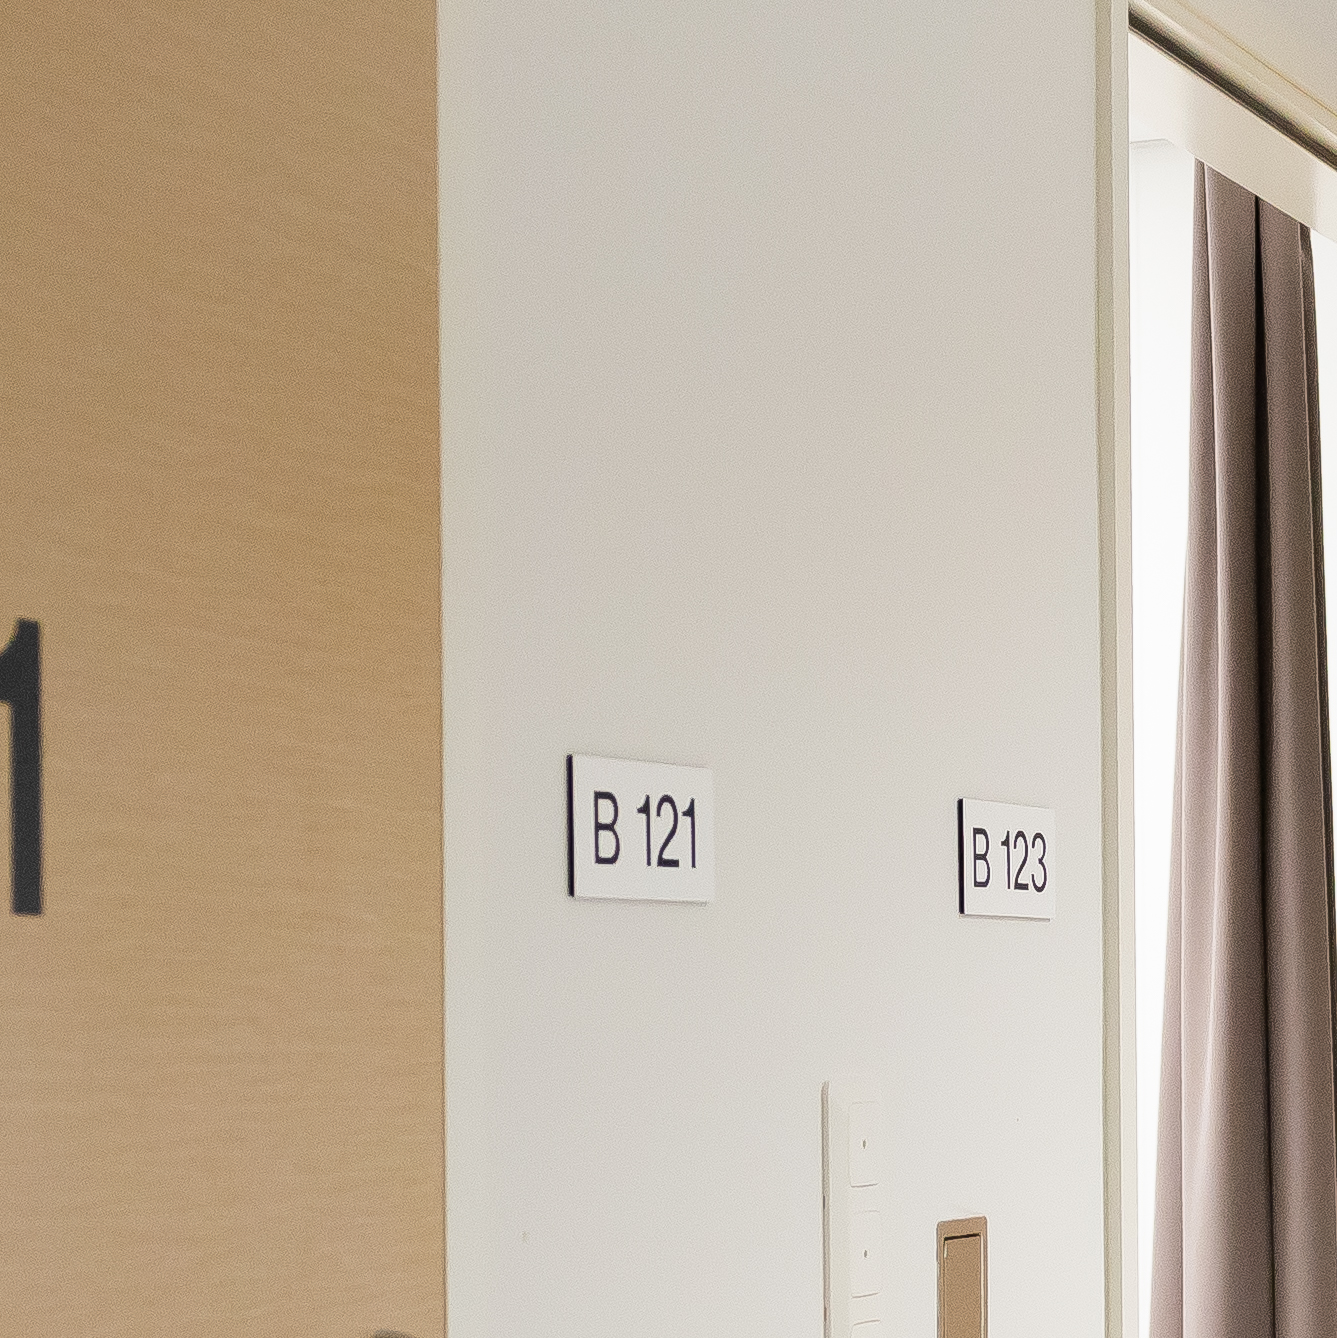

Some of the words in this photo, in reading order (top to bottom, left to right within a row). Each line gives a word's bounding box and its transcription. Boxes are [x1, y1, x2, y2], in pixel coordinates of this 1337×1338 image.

[593, 790, 621, 865] B
[636, 793, 697, 869] 121
[972, 827, 991, 888] B
[1000, 830, 1047, 893] 123
